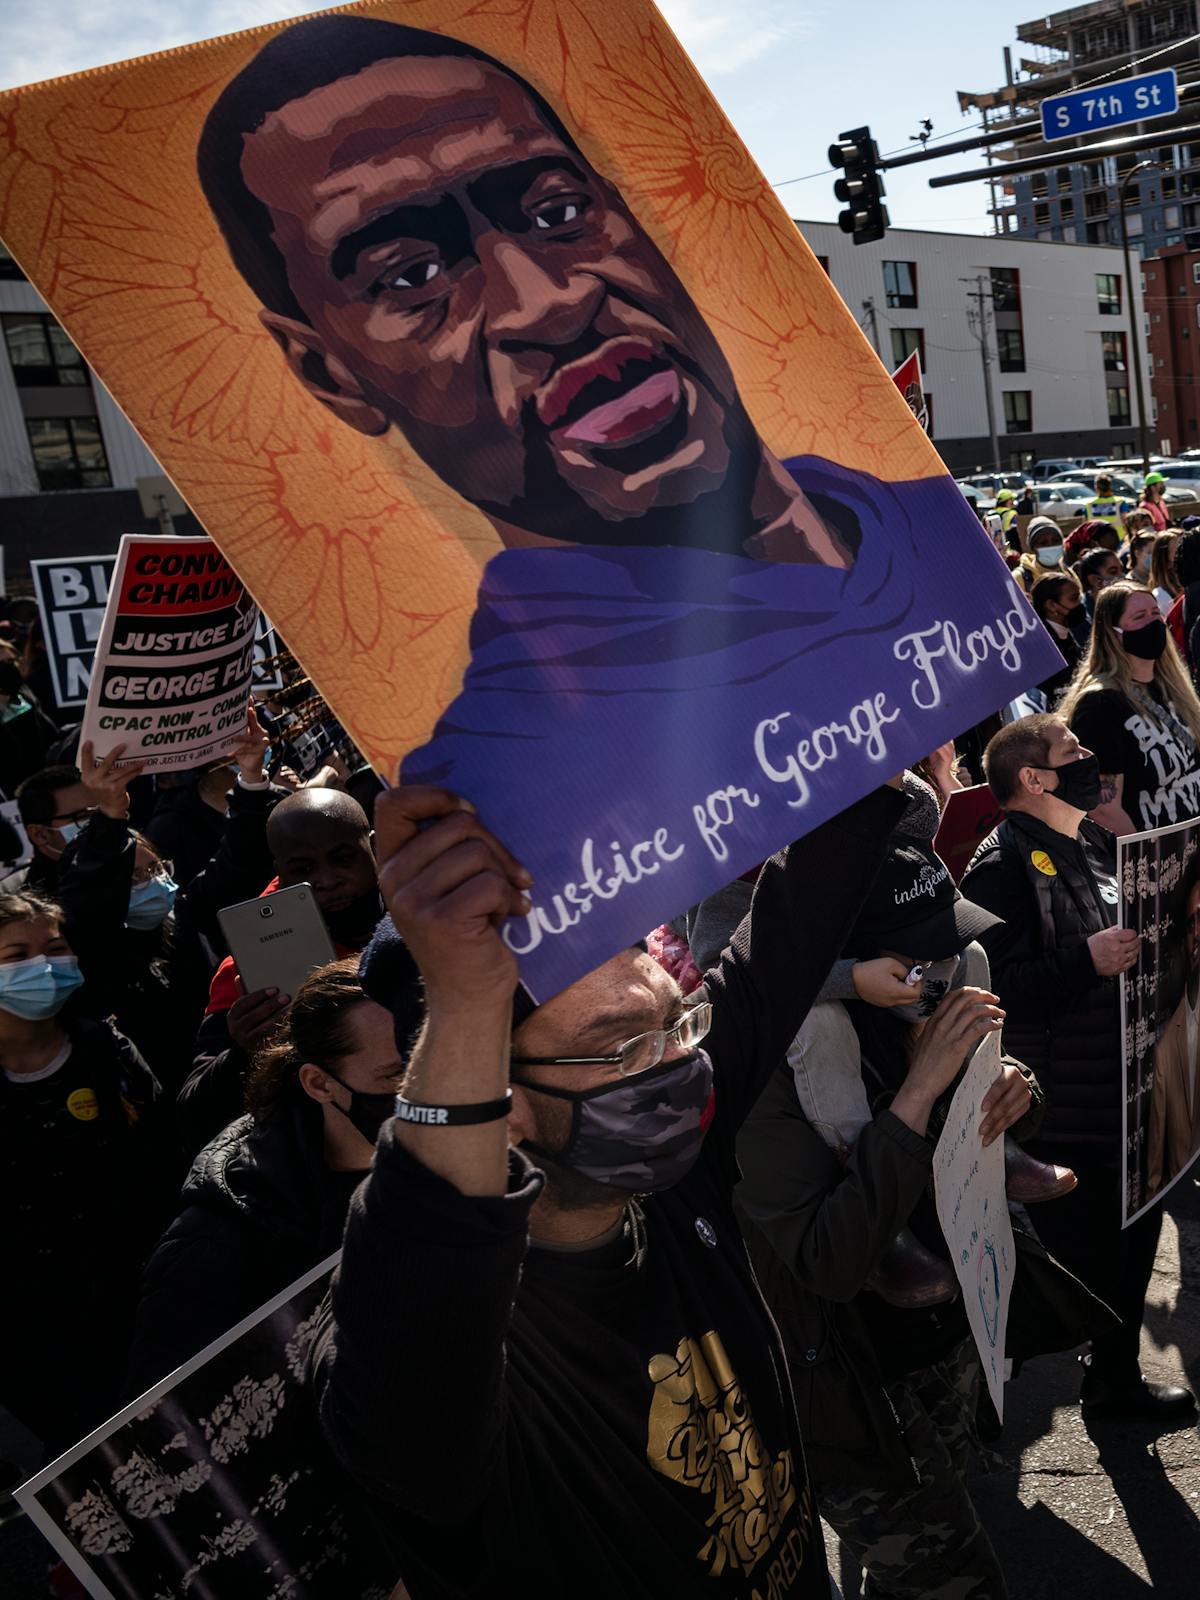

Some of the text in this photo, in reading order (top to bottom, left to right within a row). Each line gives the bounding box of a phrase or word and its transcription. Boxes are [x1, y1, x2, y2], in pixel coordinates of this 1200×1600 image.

[1056, 85, 1161, 128] S 7th St
[134, 553, 230, 577] CONV
[114, 623, 229, 651] JUSTICE
[104, 667, 221, 701] GEORGE
[98, 714, 152, 731] CPAC
[157, 710, 195, 729] NOW
[141, 722, 213, 747] CONTROL
[501, 580, 1039, 956] Justice for George Floyd
[259, 927, 294, 944] SAMSUNG
